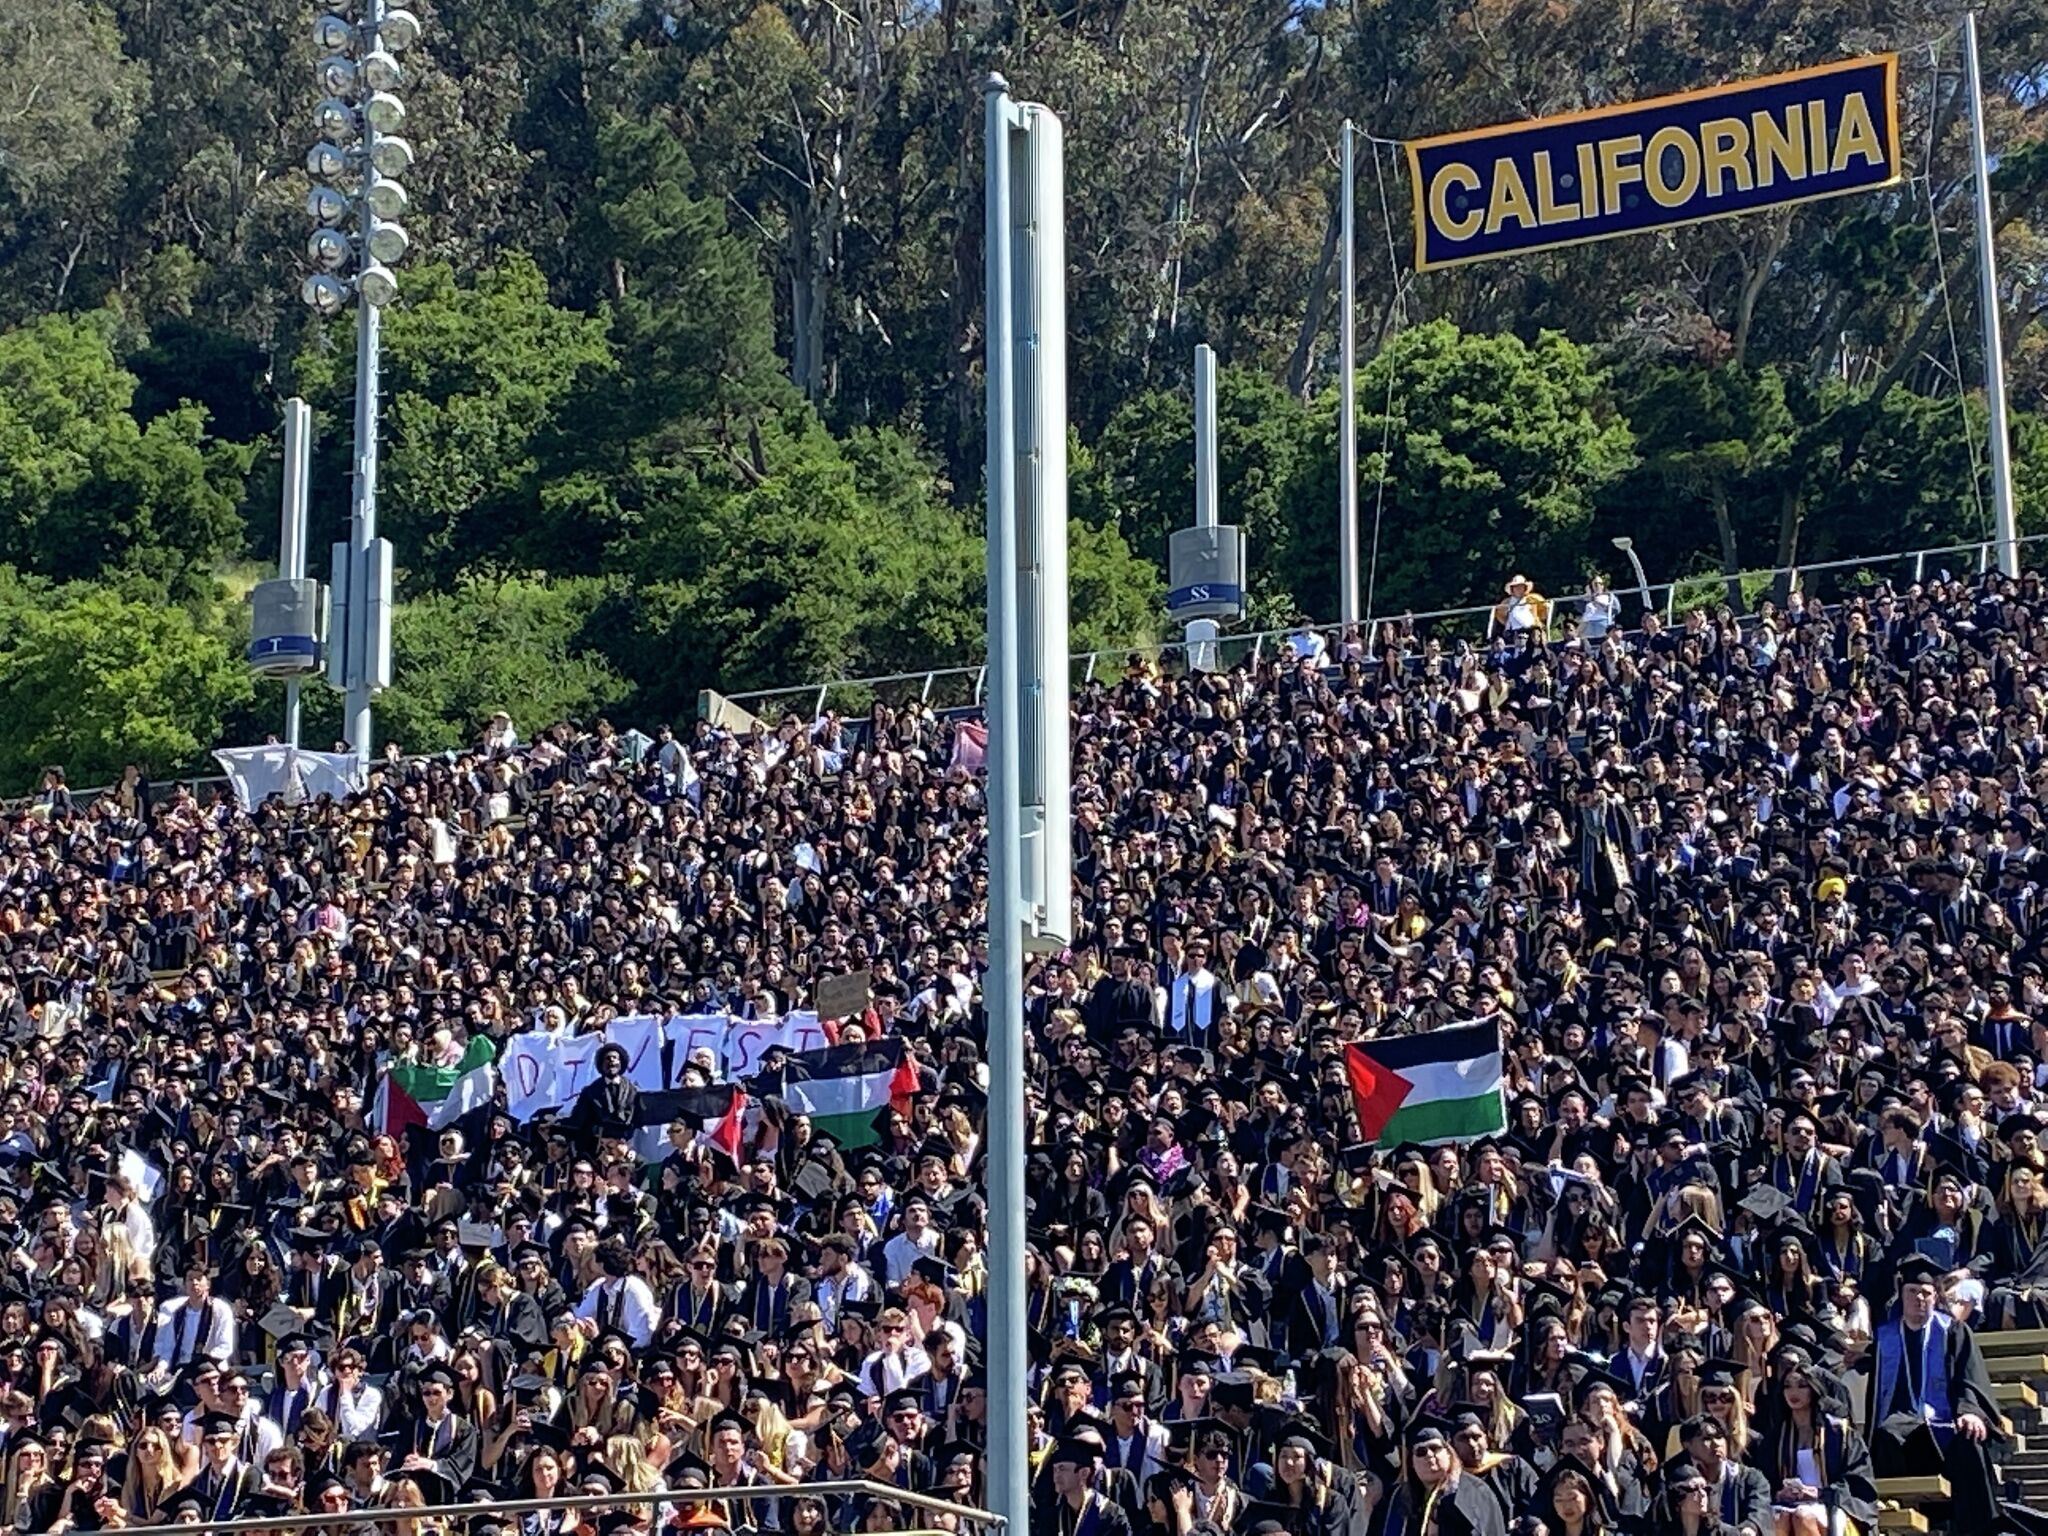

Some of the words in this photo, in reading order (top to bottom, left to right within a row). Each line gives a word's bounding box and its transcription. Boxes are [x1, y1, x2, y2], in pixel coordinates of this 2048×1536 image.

[1429, 92, 1884, 241] CALIFORNIA
[1191, 585, 1210, 601] SS
[269, 637, 282, 654] T
